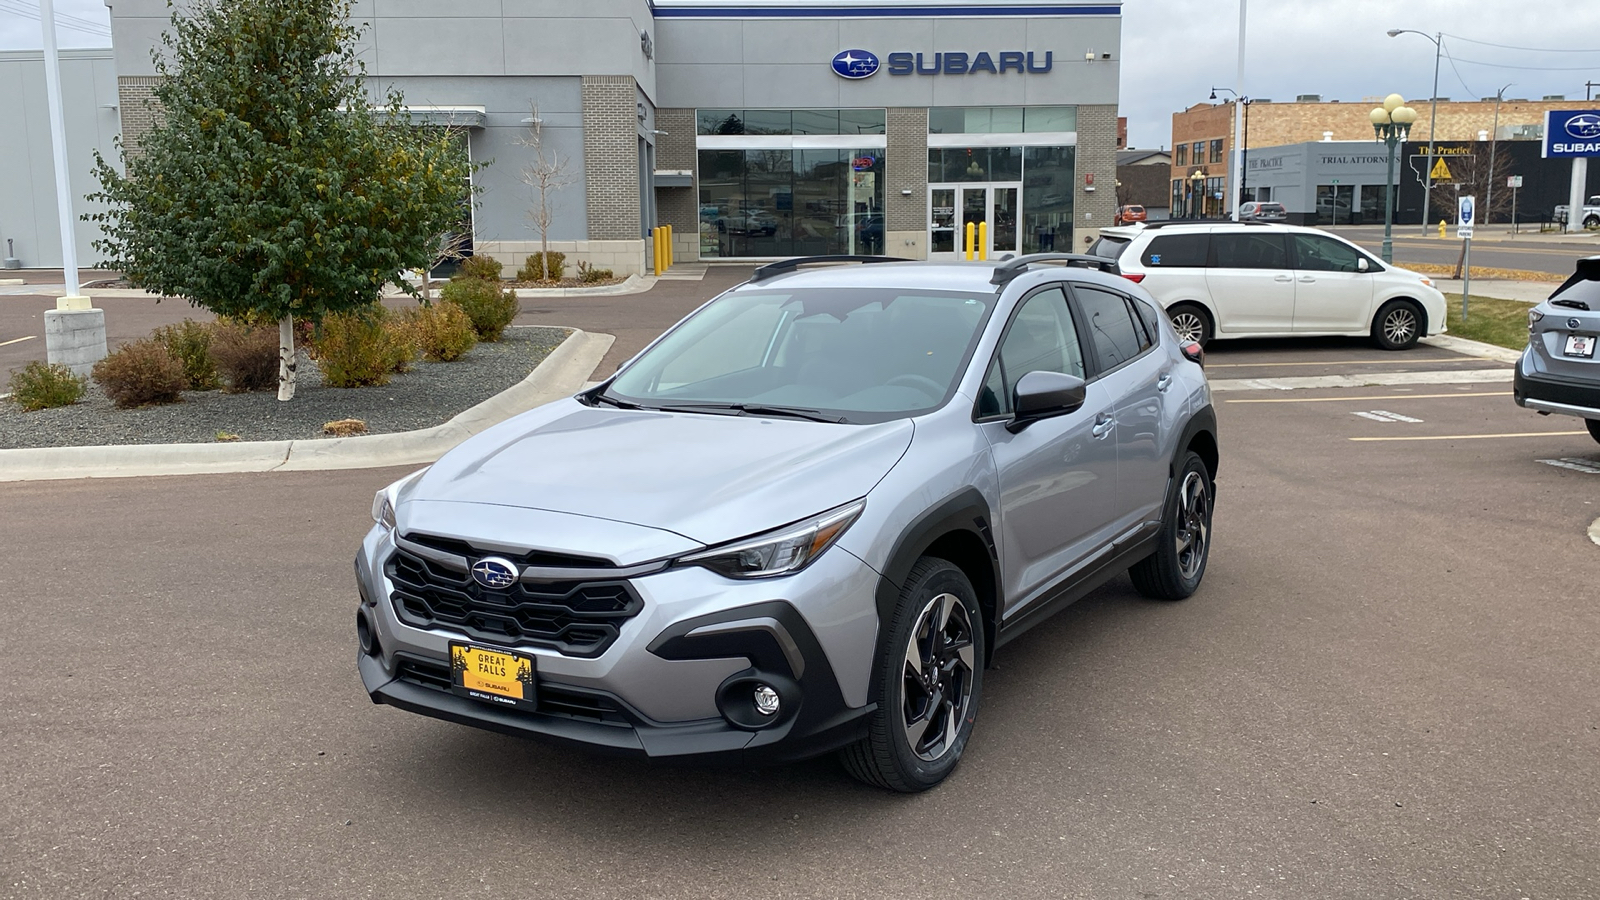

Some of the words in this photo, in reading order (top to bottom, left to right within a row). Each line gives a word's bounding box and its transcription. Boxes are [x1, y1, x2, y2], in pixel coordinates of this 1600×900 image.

[888, 51, 1053, 75] SUBARU
[1419, 146, 1435, 154] The
[852, 158, 873, 168] OPEN
[1249, 160, 1258, 169] THE
[1260, 157, 1282, 168] PRACTICE
[1322, 156, 1348, 164] TRIAL
[1350, 156, 1400, 164] ATTORNS
[478, 654, 506, 666] GREAT
[479, 664, 506, 676] FALLS
[485, 683, 509, 692] SUBARU
